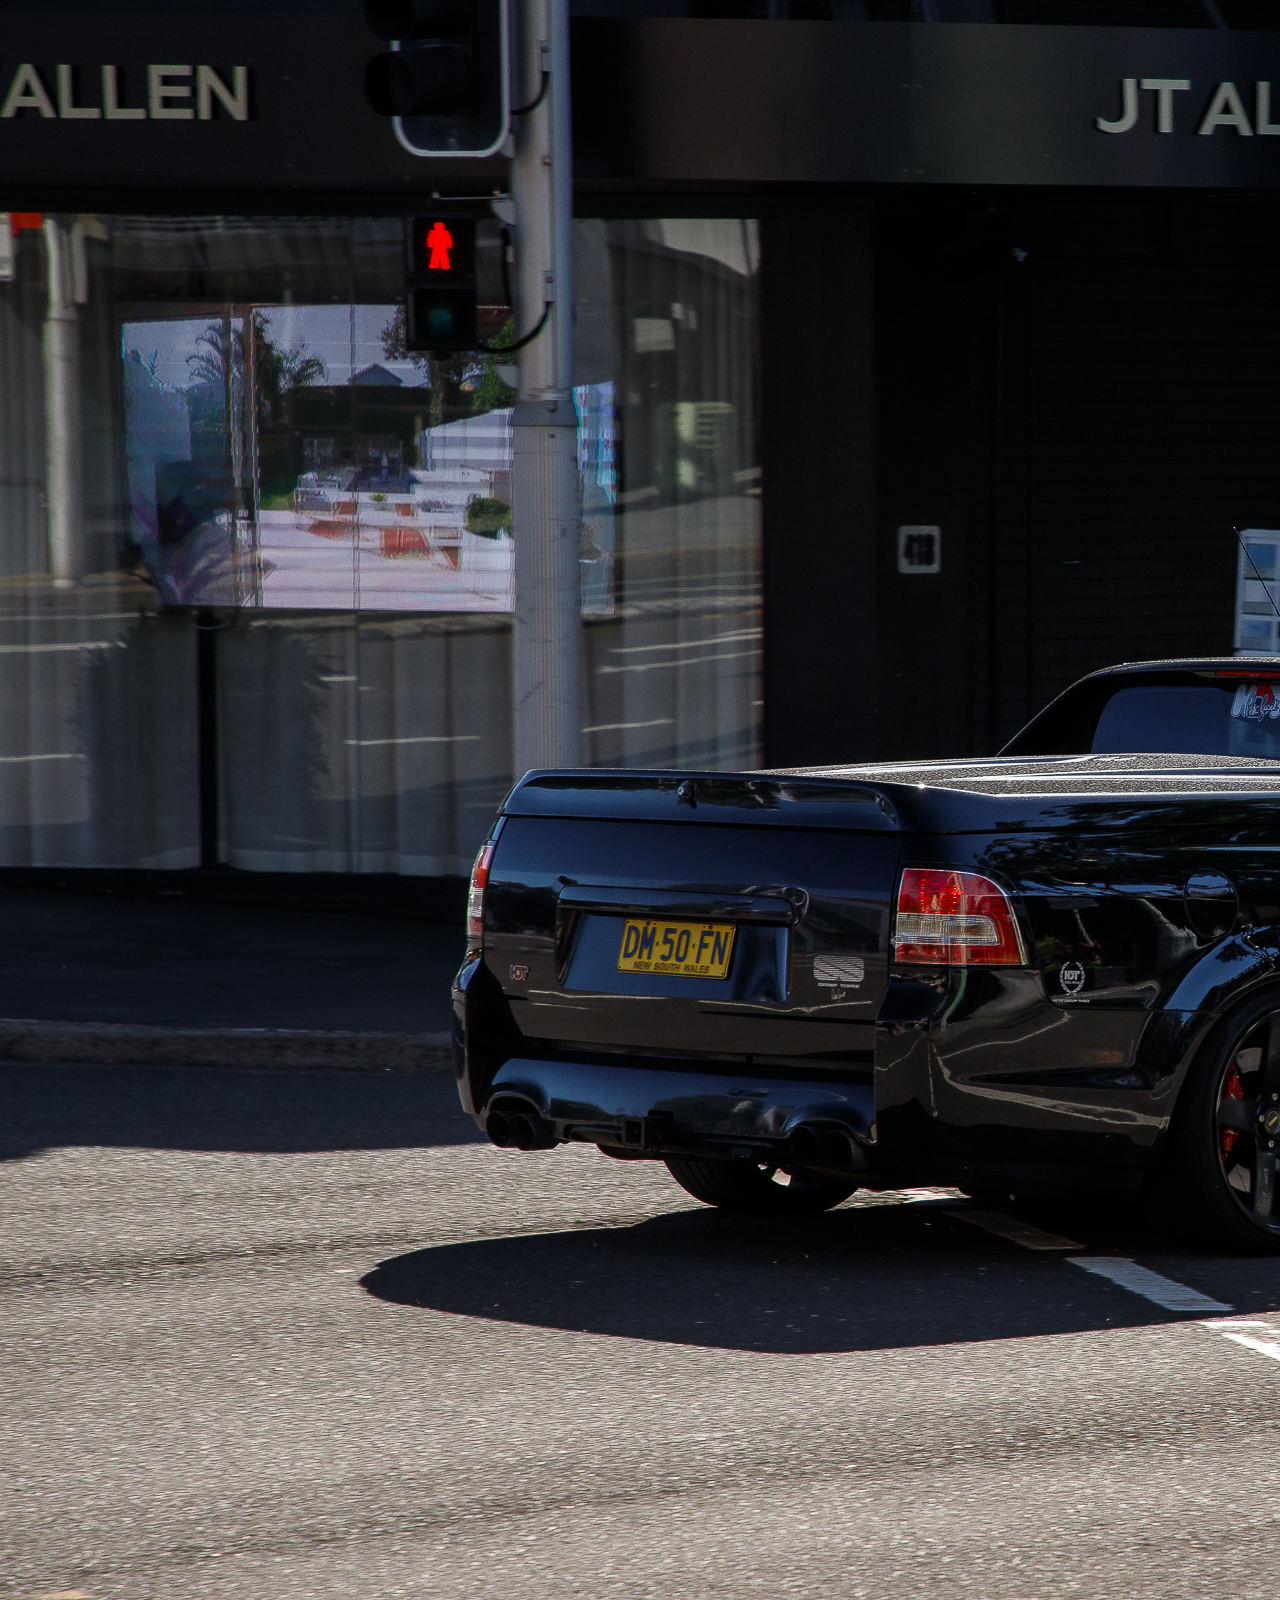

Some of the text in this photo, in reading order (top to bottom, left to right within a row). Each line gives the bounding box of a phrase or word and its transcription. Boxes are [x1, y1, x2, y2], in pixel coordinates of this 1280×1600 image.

[0, 63, 249, 121] ALLEN
[1096, 78, 1191, 134] JT
[633, 961, 710, 974] NEW SOUTH WALES
[1064, 970, 1080, 980] HDT
